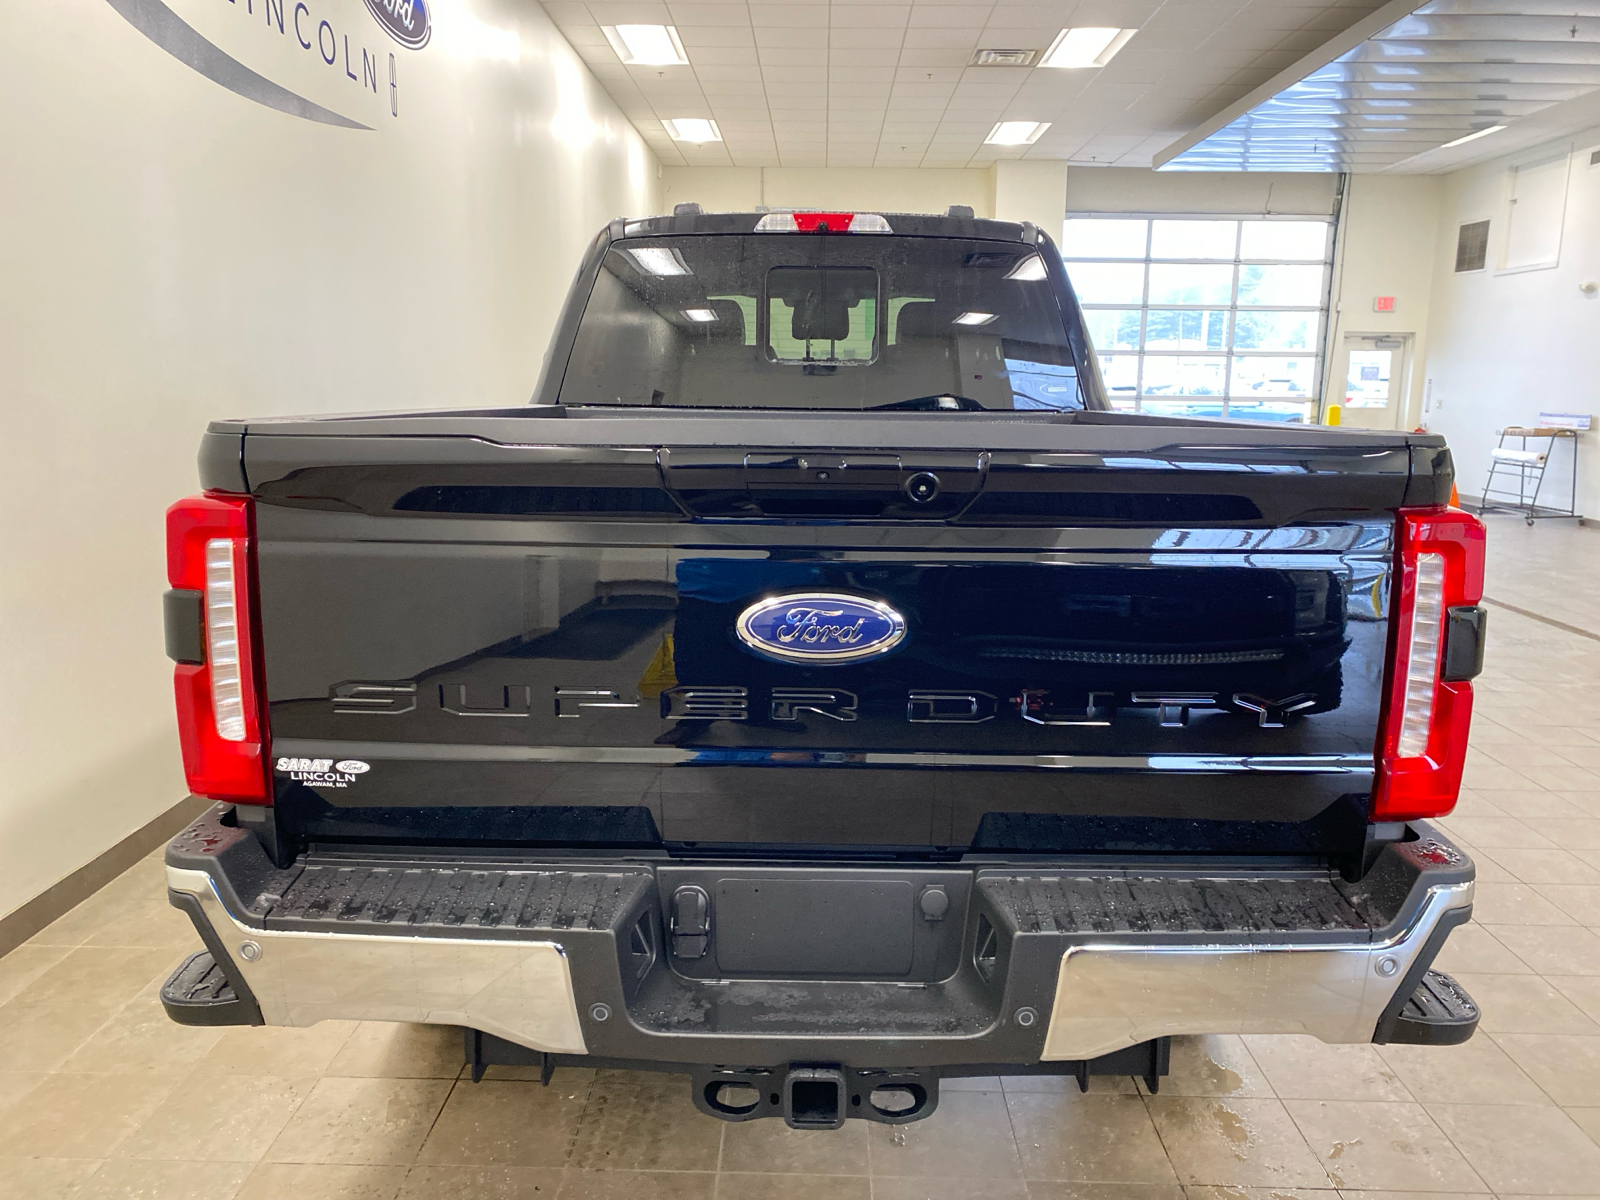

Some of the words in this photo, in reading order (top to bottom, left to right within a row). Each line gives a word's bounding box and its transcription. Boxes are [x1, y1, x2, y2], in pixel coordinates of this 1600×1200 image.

[375, 0, 415, 31] ord
[228, 0, 377, 94] NCOLN
[777, 607, 863, 643] Ford
[328, 680, 858, 722] SUPER
[907, 690, 1317, 728] DUTY
[276, 757, 333, 772] SARAT
[290, 771, 356, 782] LINCOLN
